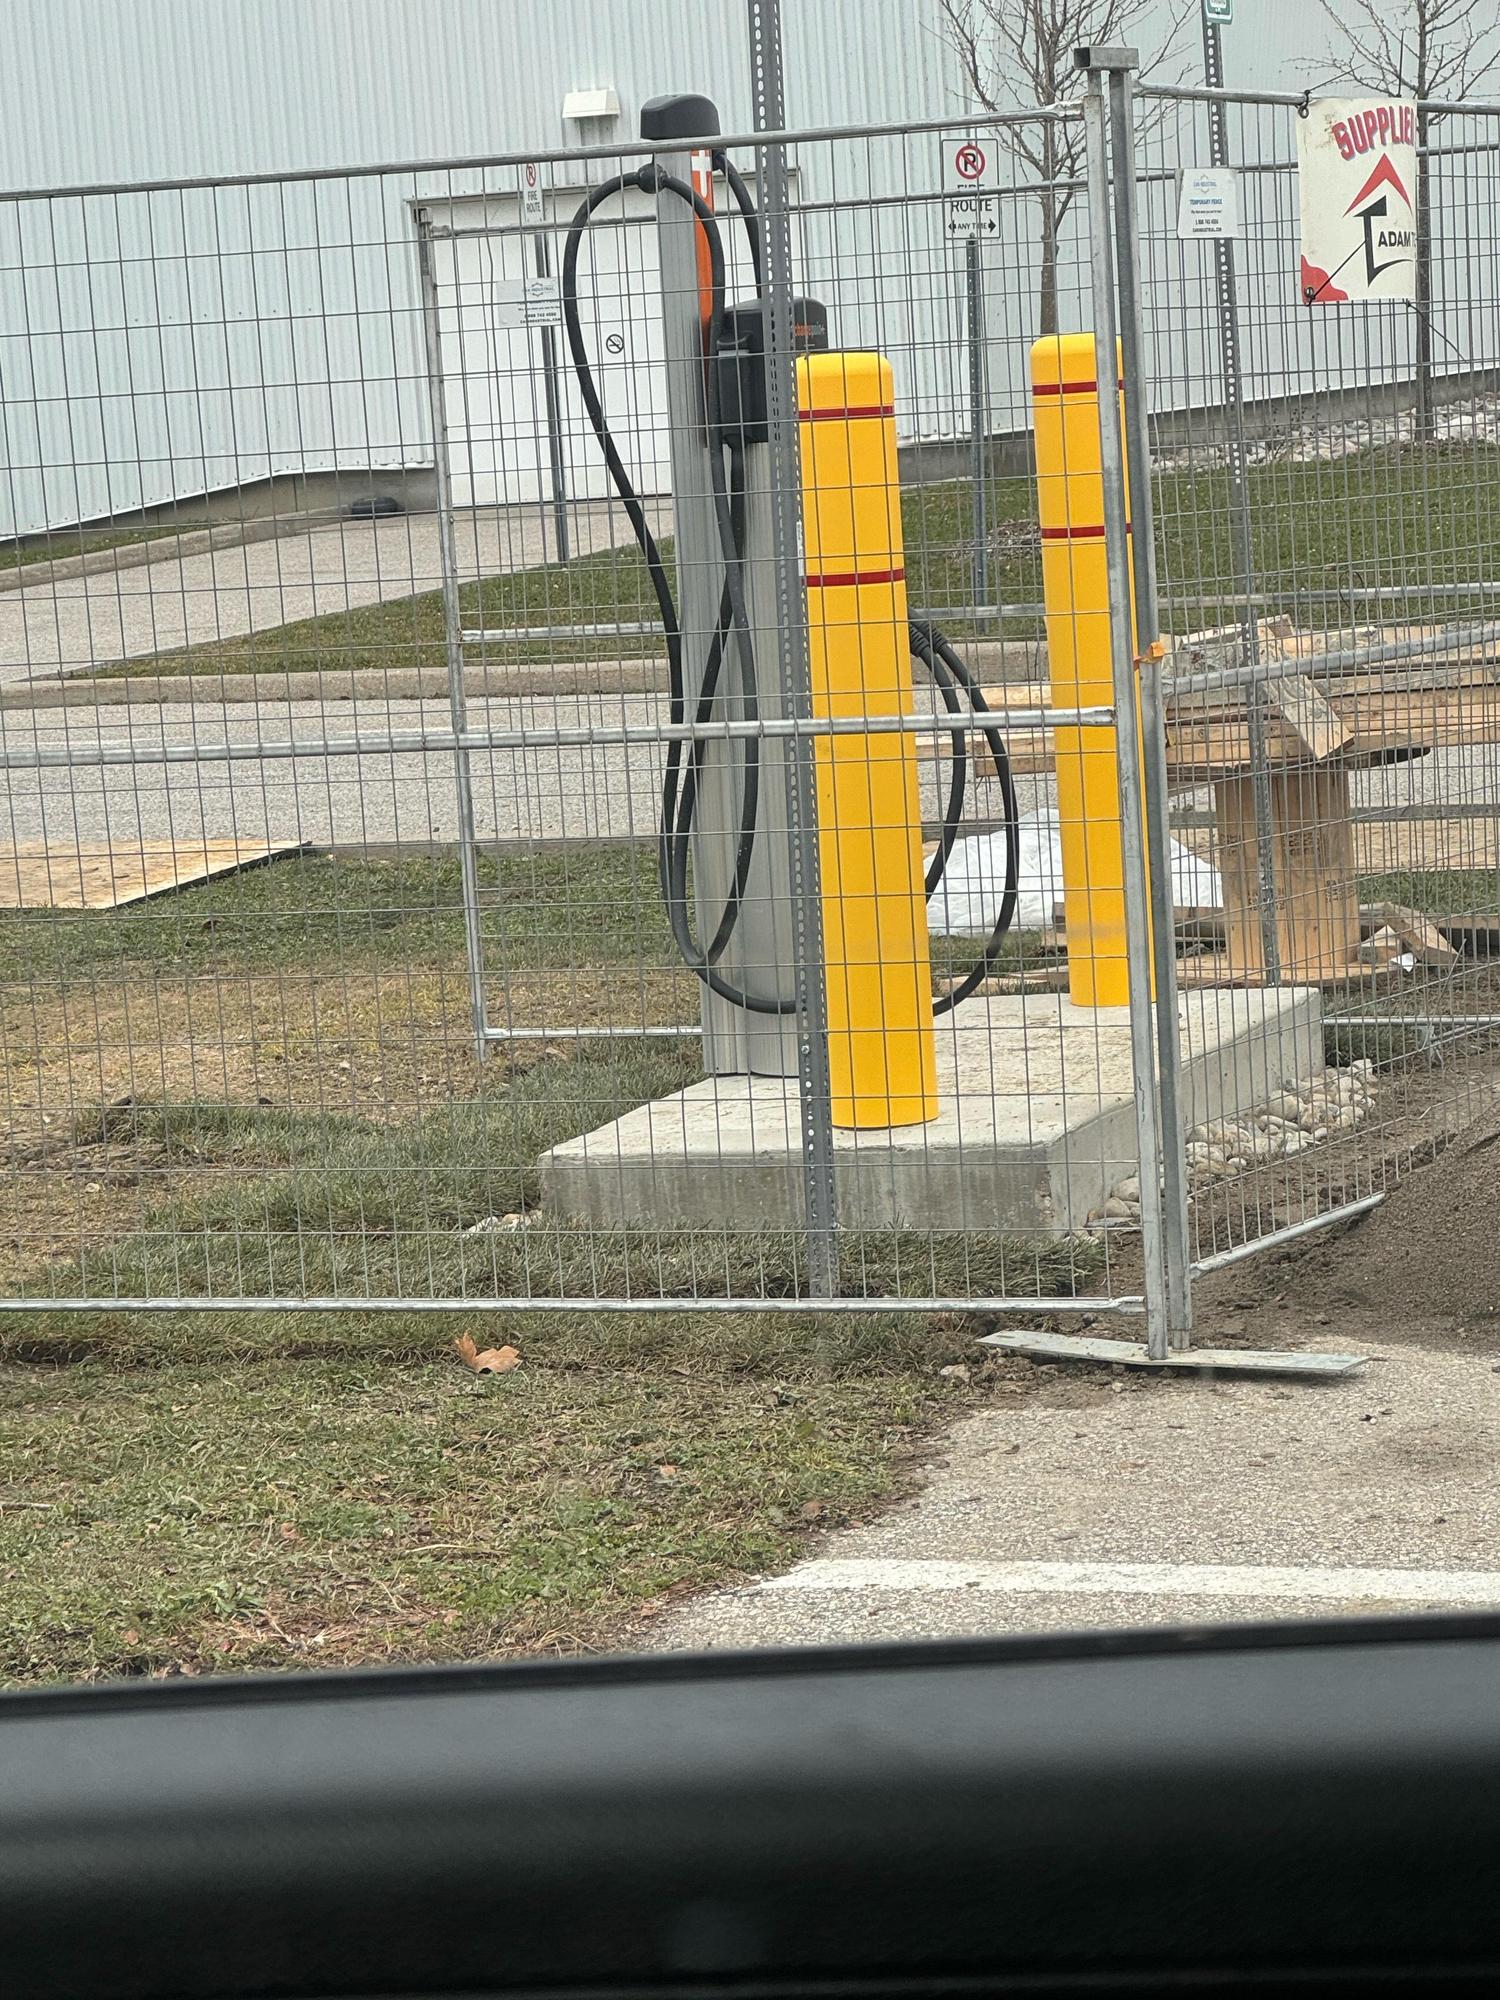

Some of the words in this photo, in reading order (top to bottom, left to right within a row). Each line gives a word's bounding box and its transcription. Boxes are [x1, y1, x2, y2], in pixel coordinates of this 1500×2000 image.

[526, 202, 541, 213] ROUTE
[951, 199, 993, 212] ROUTE
[972, 222, 987, 230] TME
